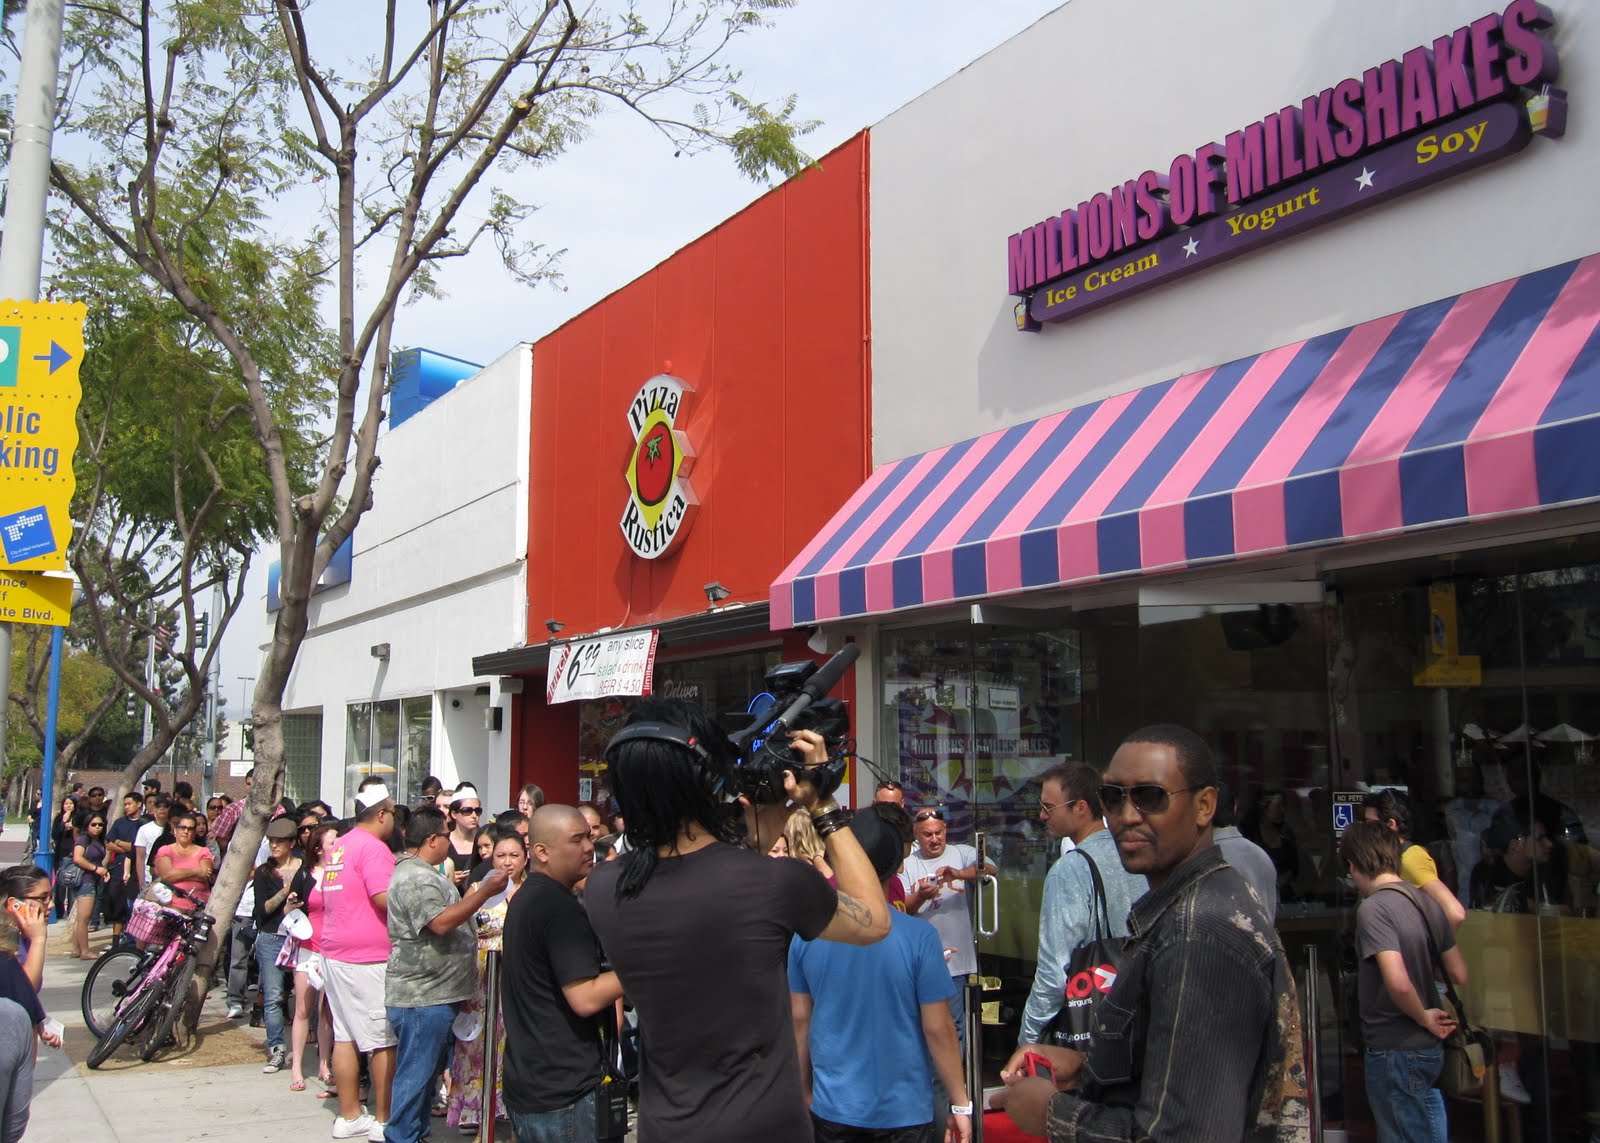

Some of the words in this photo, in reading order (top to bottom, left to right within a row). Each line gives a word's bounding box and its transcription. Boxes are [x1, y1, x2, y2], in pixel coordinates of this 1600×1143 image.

[1008, 171, 1162, 296] MILLIONS
[1169, 142, 1218, 225] OF
[1225, 0, 1543, 204] MILKSHAKES
[1046, 285, 1078, 309] Ice
[1084, 253, 1159, 292] Cream
[1225, 187, 1321, 236] Yogurt
[1416, 120, 1488, 164] Soy
[630, 386, 678, 434] Pizza
[622, 494, 685, 553] Rustica
[22, 607, 54, 620] Blvd.
[607, 639, 622, 654] any
[624, 636, 645, 651] slice
[597, 662, 617, 677] salad
[622, 660, 644, 674] drink
[599, 679, 616, 695] BEER
[623, 679, 641, 693] 4.50
